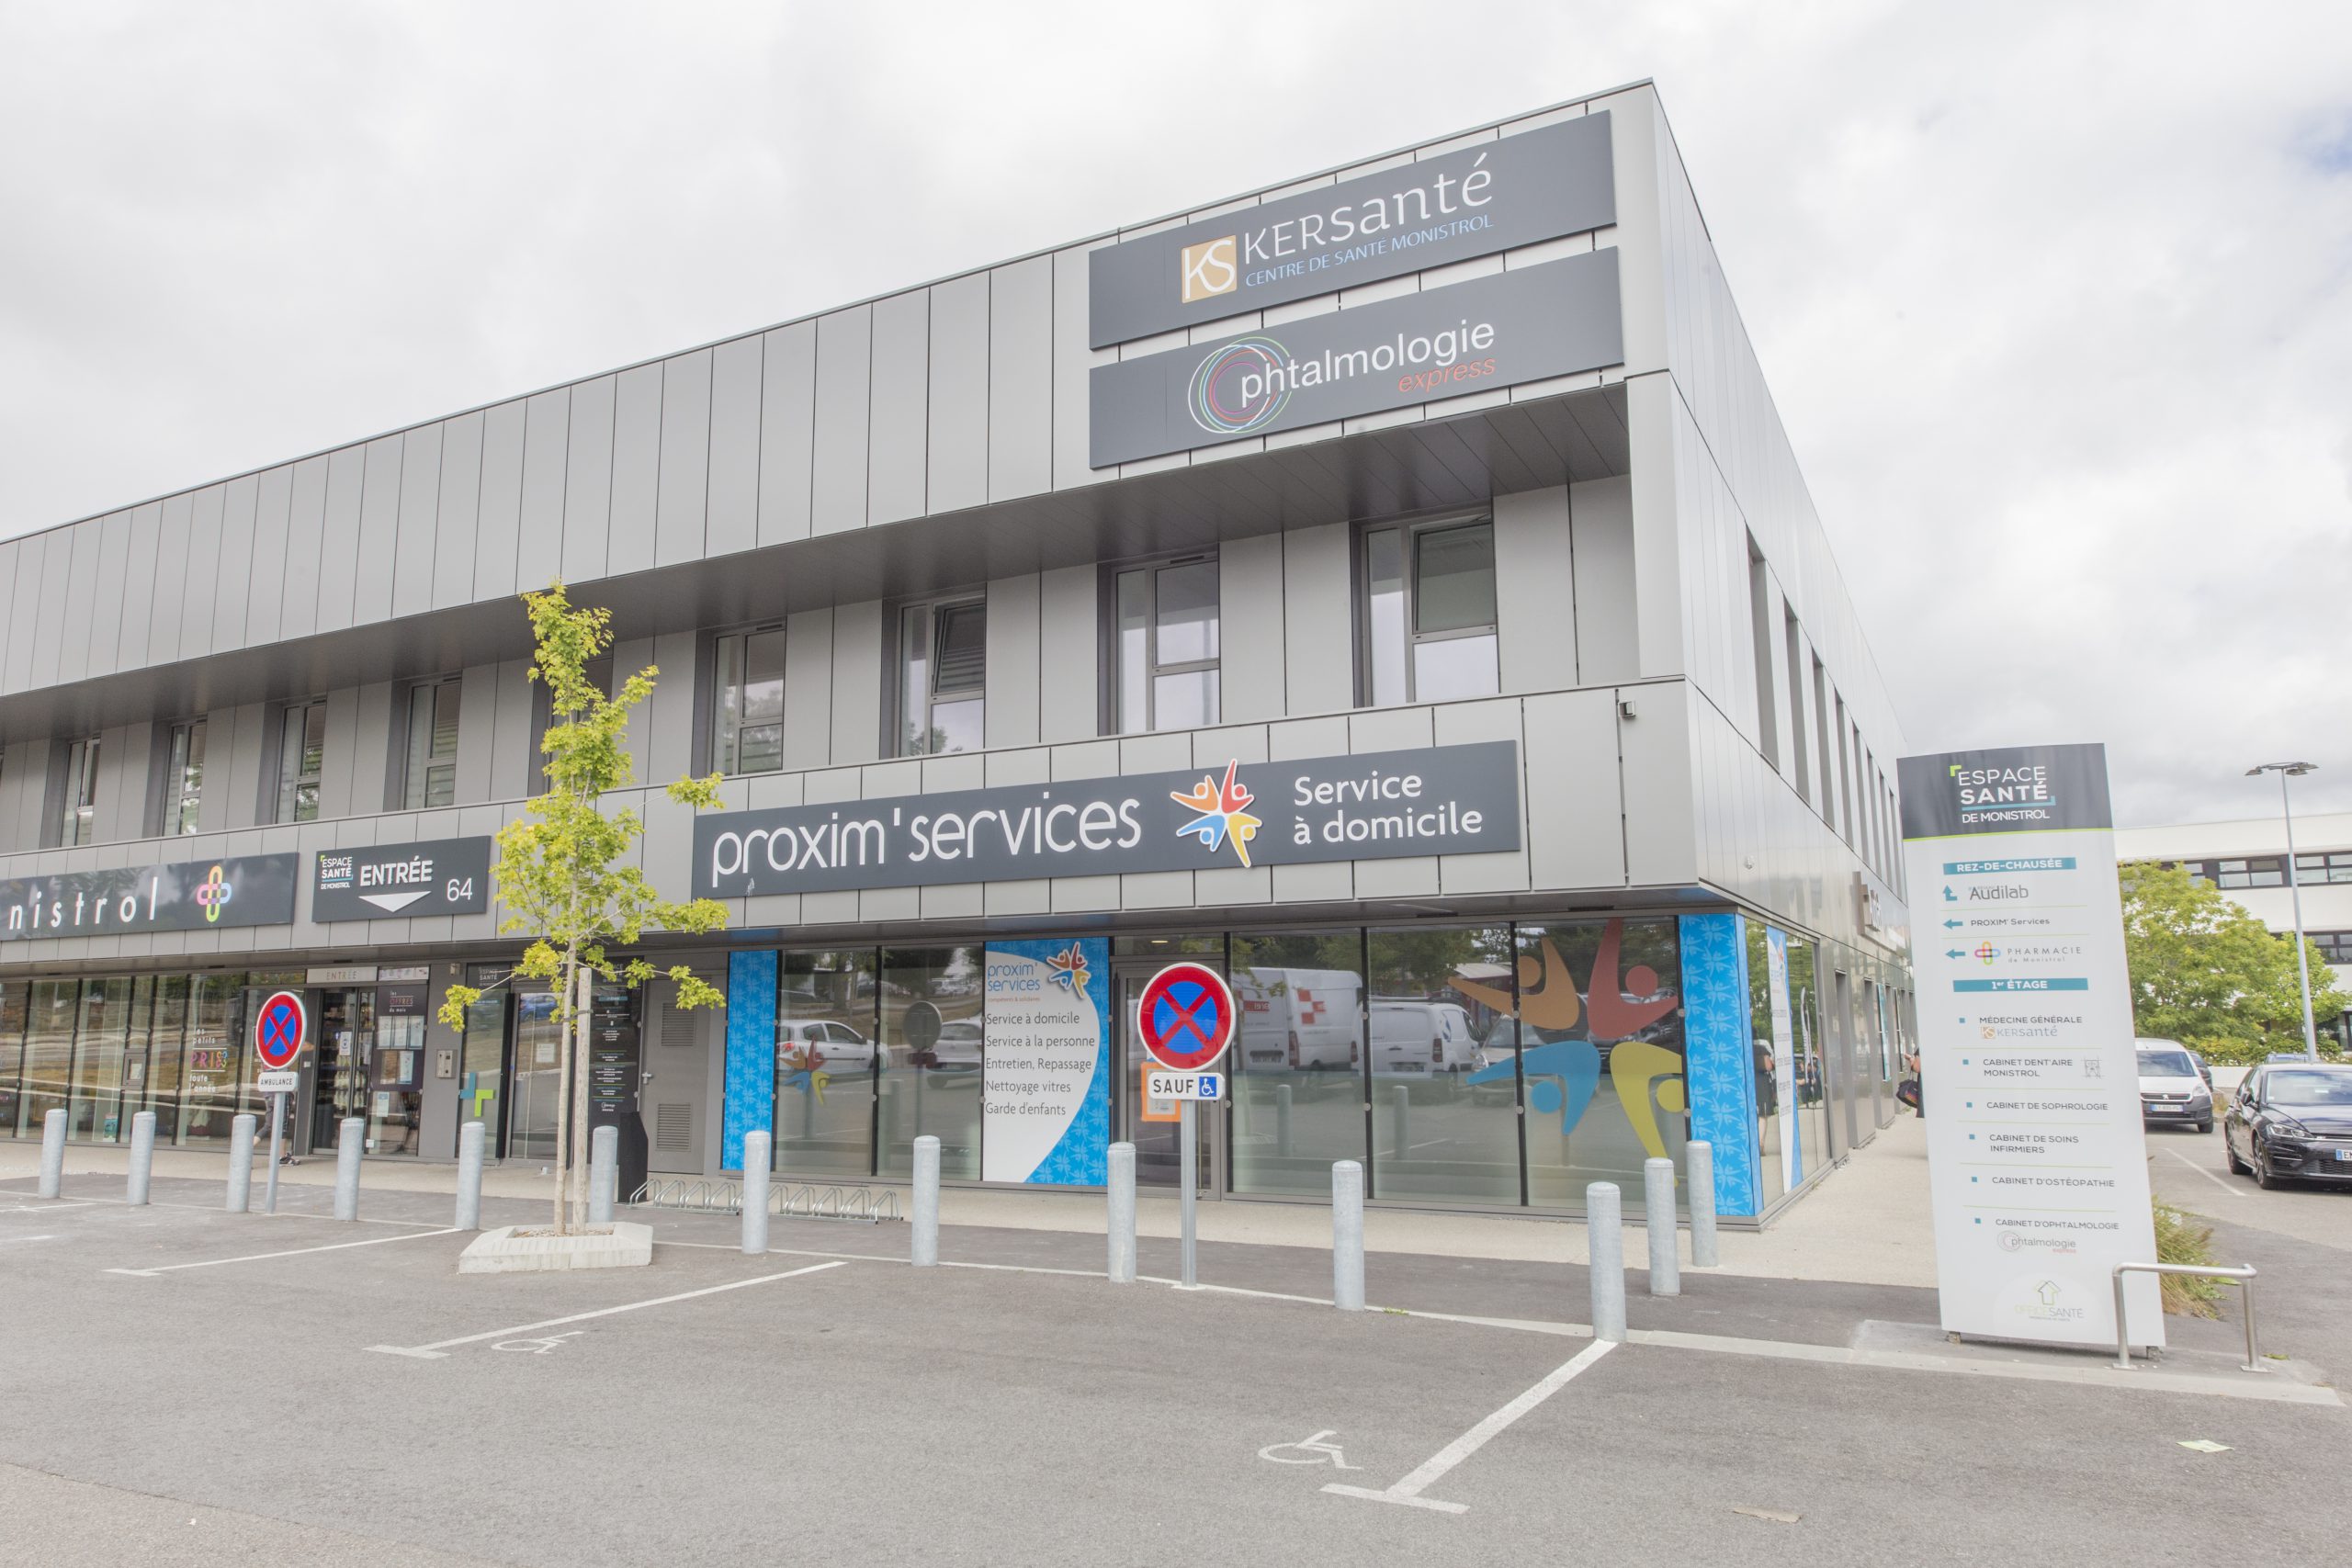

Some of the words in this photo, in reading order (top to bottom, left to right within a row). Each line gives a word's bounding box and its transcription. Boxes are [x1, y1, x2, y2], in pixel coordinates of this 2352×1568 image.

[1245, 260, 1306, 288] CENTRE
[1308, 254, 1330, 273] DE
[1335, 237, 1387, 267] SANTÉ
[1392, 214, 1494, 254] MONISTROL
[1398, 356, 1496, 395] express
[1958, 766, 2047, 786] ESPACE
[1295, 773, 1422, 807] Service
[1961, 781, 2048, 805] SANTÉ
[1962, 813, 1978, 823] DE
[1981, 809, 2050, 822] MONISTROL
[1294, 815, 1312, 845] à
[1323, 802, 1483, 844] domicile
[322, 857, 352, 868] ESPACE
[1957, 858, 2063, 872] REZ-DE-CHAUSÉE
[322, 865, 351, 879] SANTÉ
[360, 855, 433, 886] ENTRÉE
[447, 877, 472, 902] 64
[1970, 885, 2029, 900] Audilab
[9, 876, 158, 931] nistrol
[2007, 947, 2081, 955] PHARMACIE
[988, 977, 1040, 992] services
[2007, 978, 2048, 988] ÉTAGE
[986, 1013, 1023, 1025] Service
[1025, 1013, 1032, 1024] à
[1034, 1011, 1080, 1025] domicile
[2030, 1015, 2083, 1023] GÉNÉRALE
[986, 1035, 1023, 1047] Service
[1025, 1035, 1032, 1047] à
[1034, 1035, 1044, 1047] la
[1046, 1037, 1095, 1050] personne
[986, 1058, 1035, 1071] Entretien,
[1037, 1058, 1091, 1073] Repassage
[261, 1077, 293, 1086] AMBULANCE
[986, 1081, 1039, 1095] Nettoyage
[1042, 1081, 1071, 1093] vitres
[1153, 1079, 1193, 1093] SAUF
[985, 1103, 1016, 1115] Garde
[1019, 1102, 1067, 1115] d'enfants
[2041, 1102, 2109, 1111] SOPHROLOGIE
[2049, 1135, 2079, 1144] SOINS
[1990, 1145, 2045, 1154] INFIRMIERS
[1992, 1177, 2034, 1185] CABINET
[2036, 1177, 2115, 1188] D'OSTÉOPATHIE
[1996, 1219, 2033, 1227] CABINET
[2034, 1220, 2120, 1230] D'OPHTALMOLOGIE
